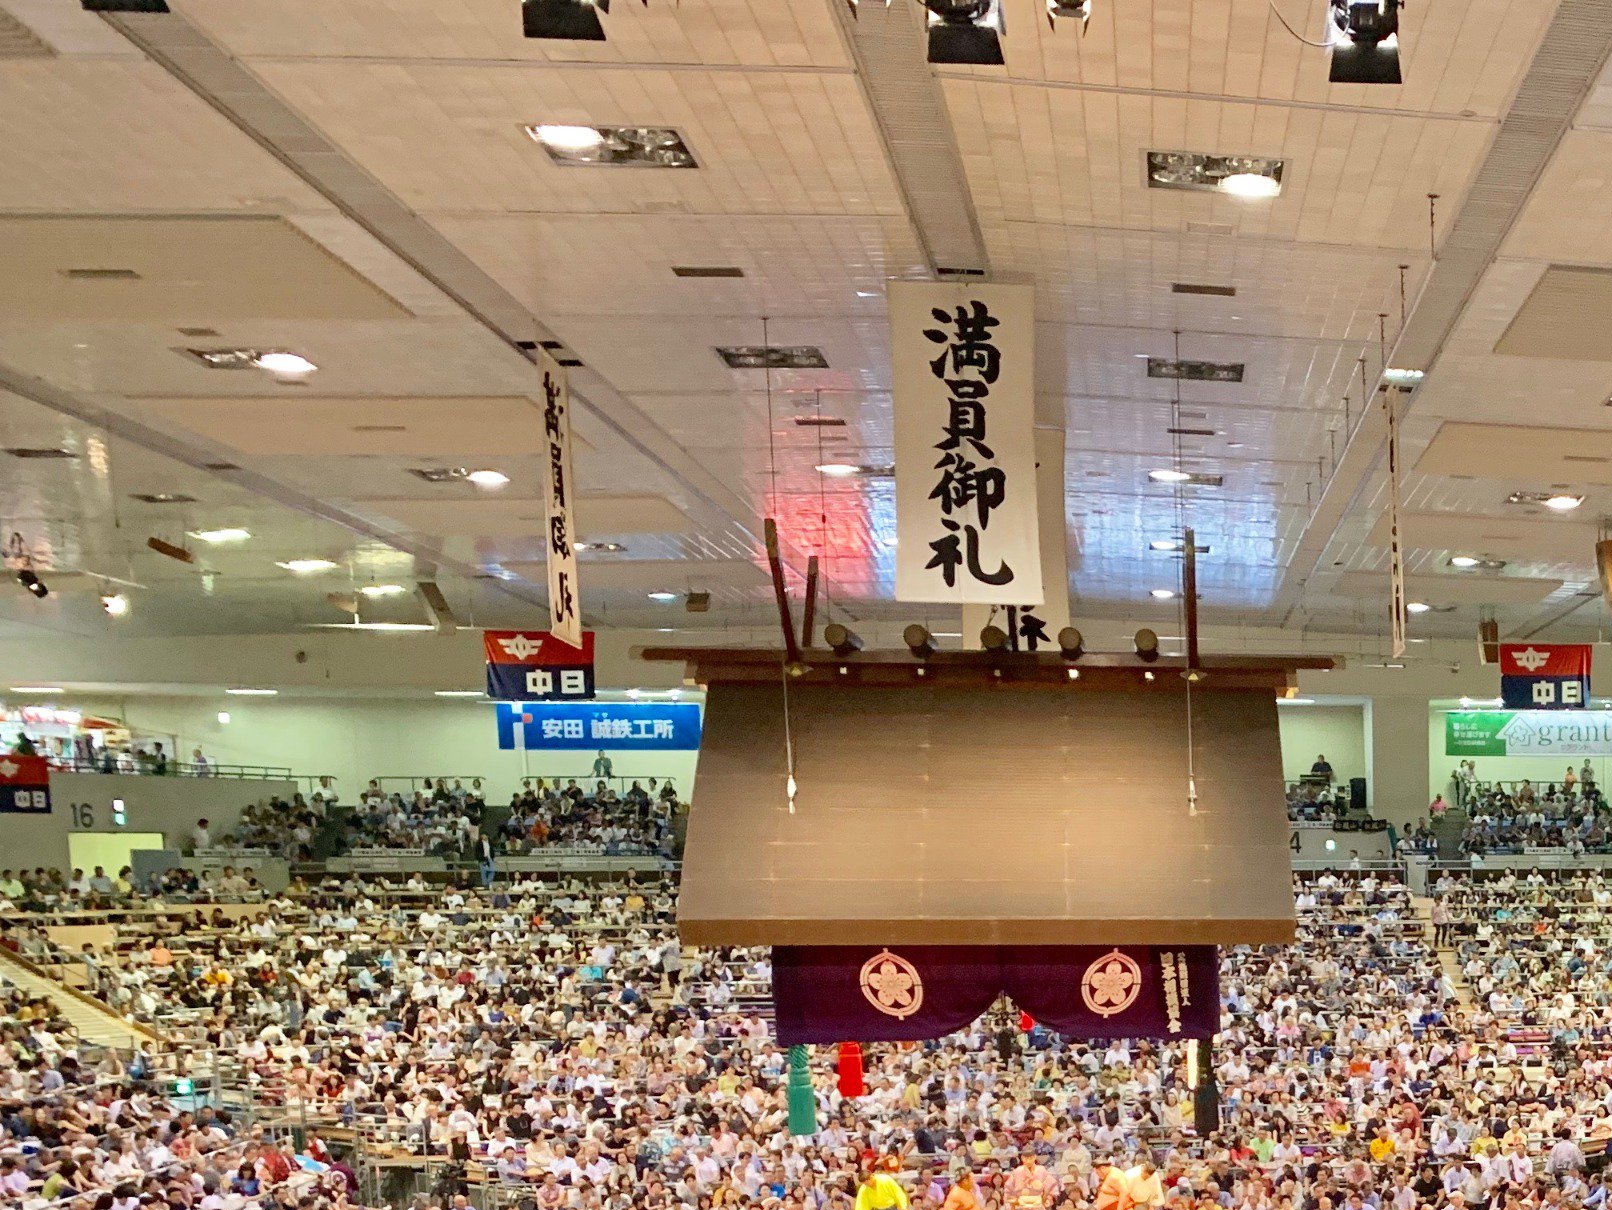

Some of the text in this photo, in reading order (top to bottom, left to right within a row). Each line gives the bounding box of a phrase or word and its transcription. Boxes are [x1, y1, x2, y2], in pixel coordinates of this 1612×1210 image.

[923, 300, 1014, 588] 満員御礼
[525, 669, 586, 695] 中日
[1532, 680, 1582, 705] 中日
[542, 719, 584, 739] 安田
[1538, 720, 1612, 747] grant
[70, 802, 95, 828] 16
